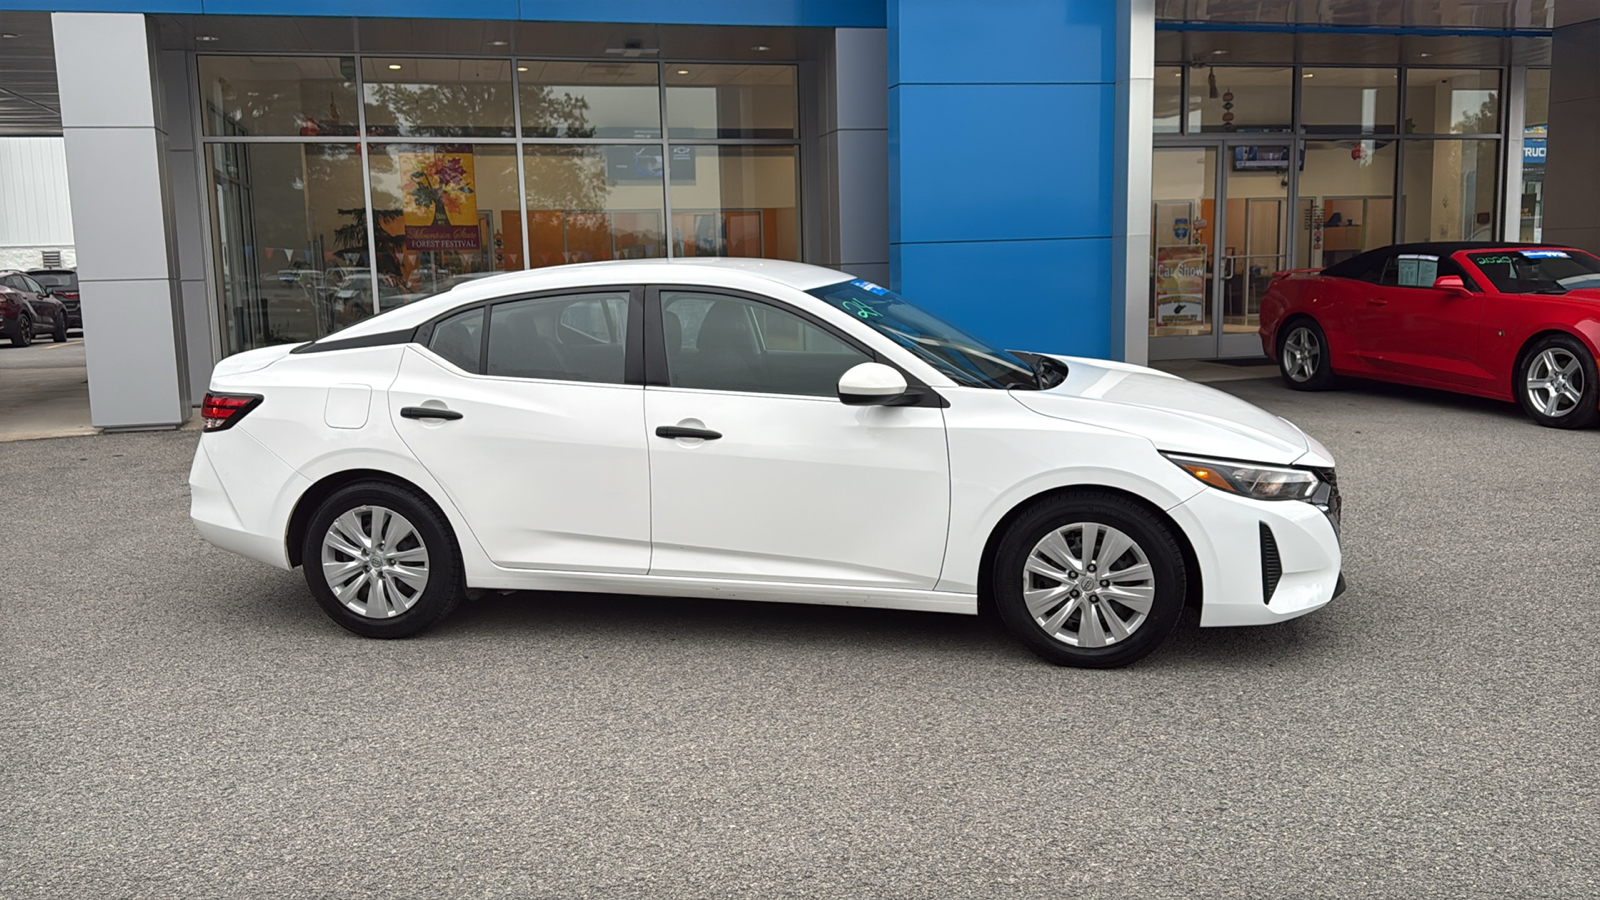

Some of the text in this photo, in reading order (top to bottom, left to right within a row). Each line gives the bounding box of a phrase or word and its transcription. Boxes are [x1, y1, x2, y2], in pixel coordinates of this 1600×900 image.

[407, 227, 477, 239] Mountain State
[411, 240, 440, 248] FOREST
[1158, 263, 1204, 278] Car Show
